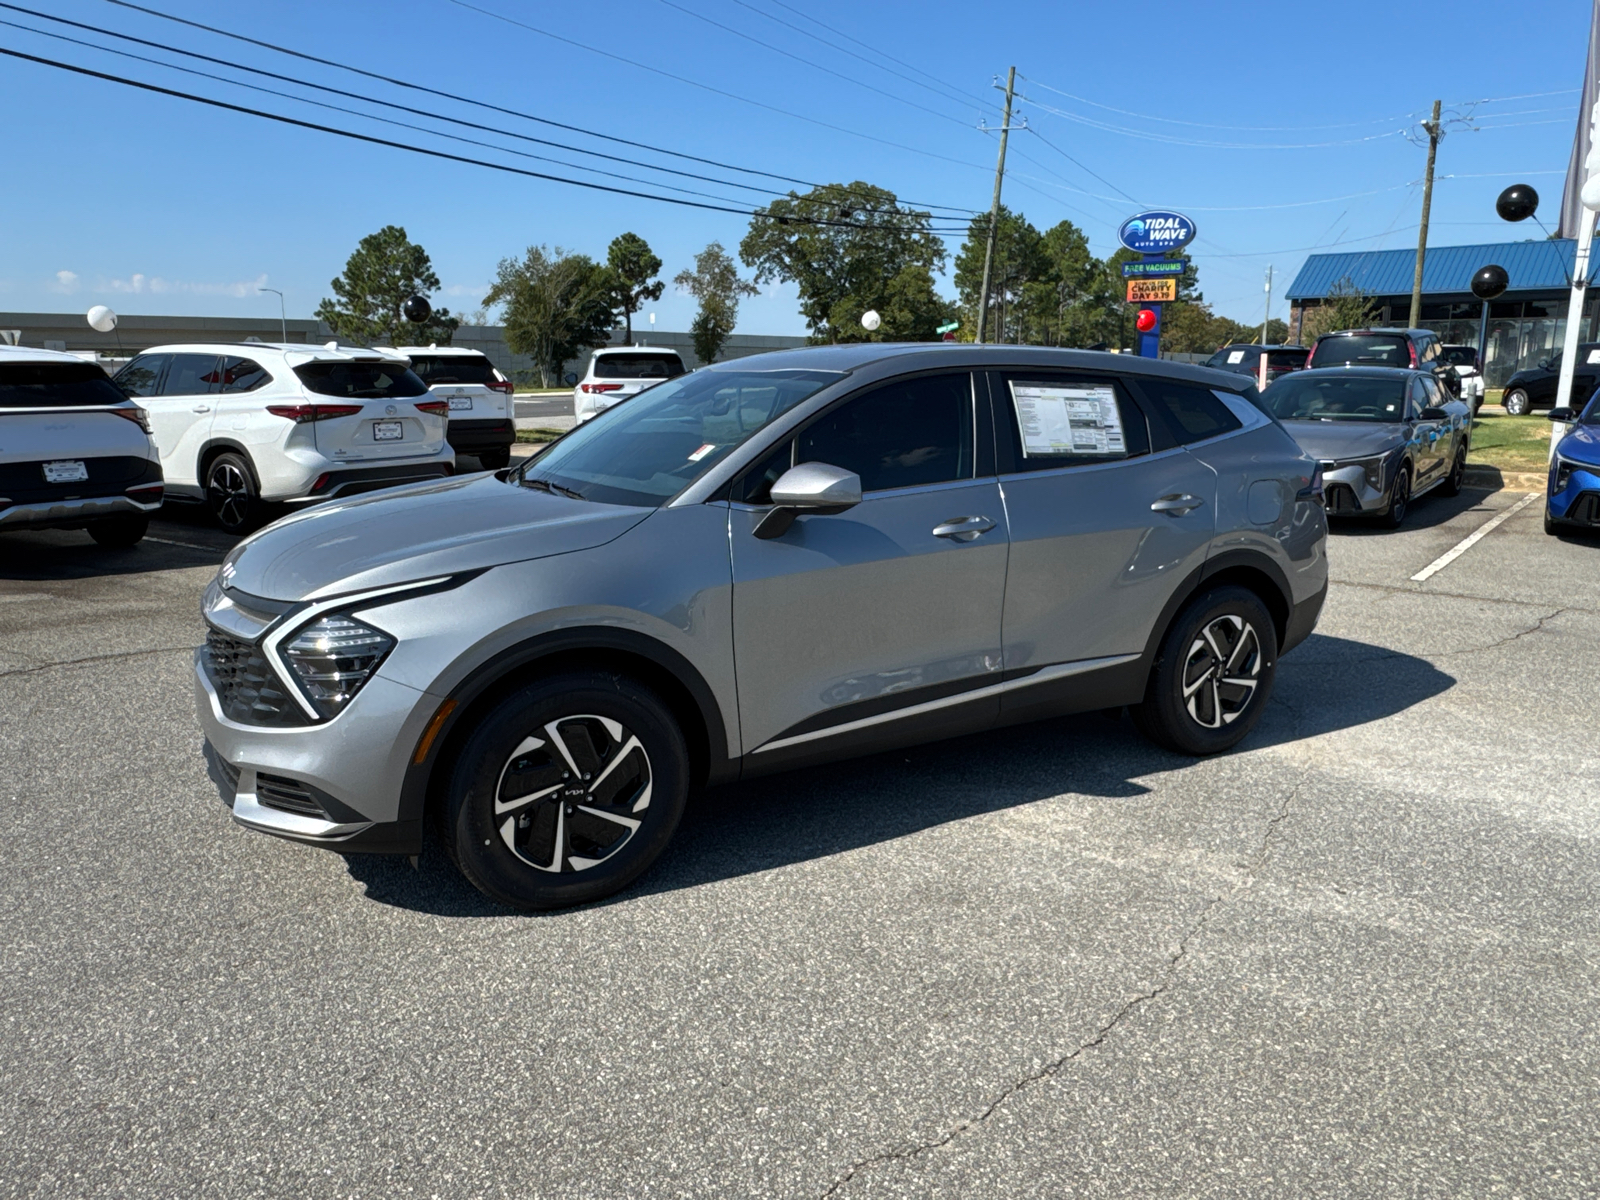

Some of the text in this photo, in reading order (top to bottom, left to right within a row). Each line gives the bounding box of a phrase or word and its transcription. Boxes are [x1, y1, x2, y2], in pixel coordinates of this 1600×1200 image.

[1145, 218, 1180, 229] TIDAL
[1149, 228, 1187, 240] WAVE
[1124, 263, 1181, 273] FREE VACUUMS
[1131, 285, 1172, 293] CHARITY
[1132, 292, 1151, 300] DAY
